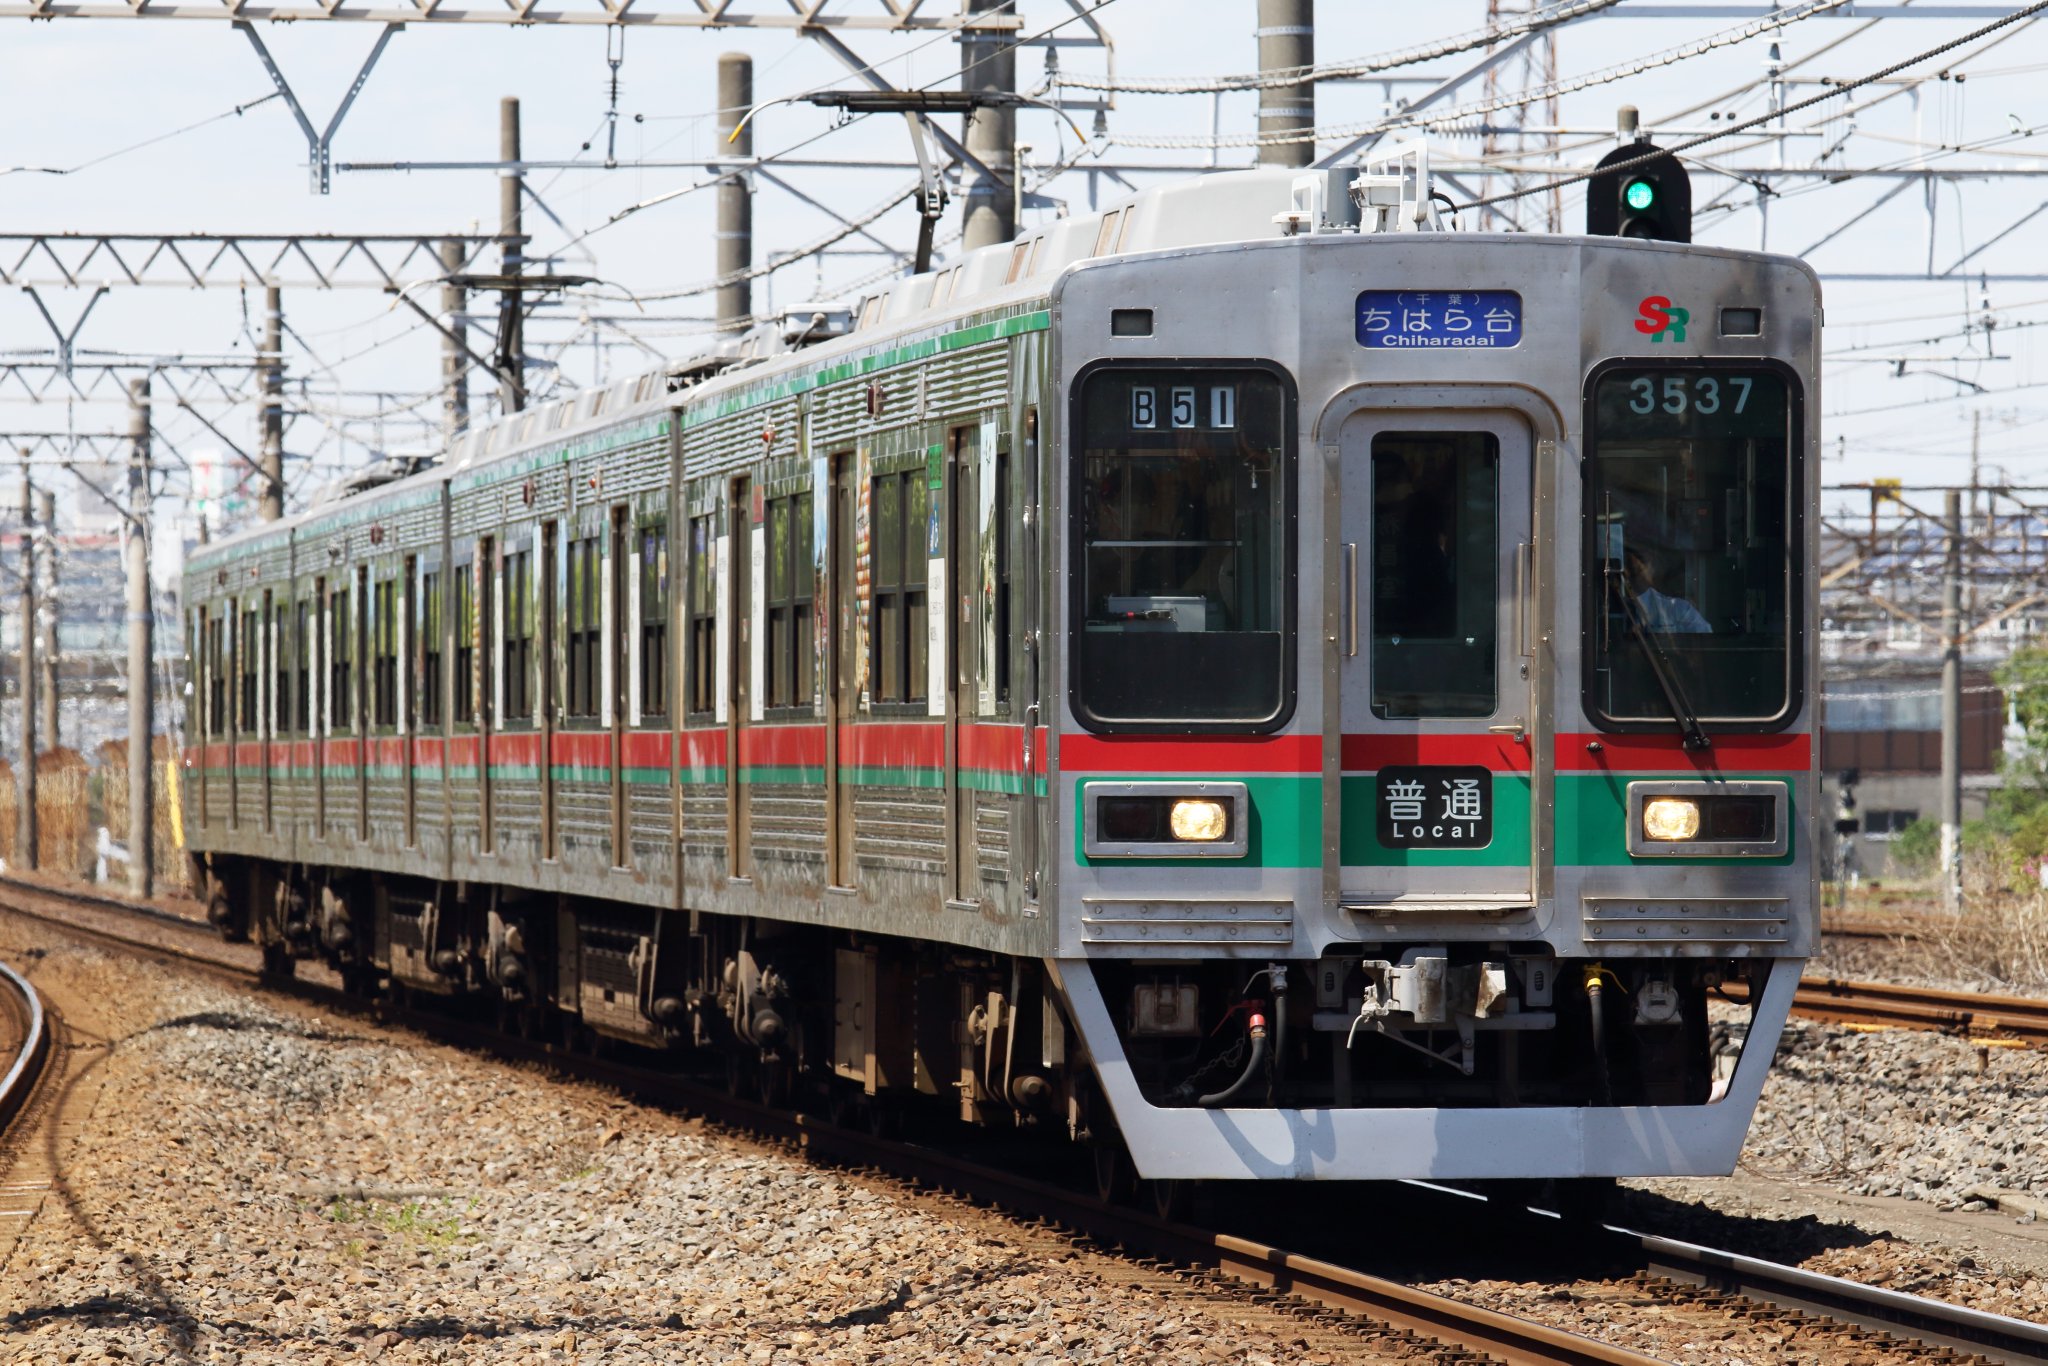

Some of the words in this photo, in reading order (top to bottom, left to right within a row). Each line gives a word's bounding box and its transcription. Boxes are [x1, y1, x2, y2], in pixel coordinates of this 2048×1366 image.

[1362, 307, 1516, 333] ちはら台
[1634, 295, 1690, 343] SR
[1382, 334, 1495, 346] Chiharadai
[1629, 377, 1753, 415] 3537
[1385, 779, 1483, 820] 普通
[1393, 822, 1475, 838] Local
